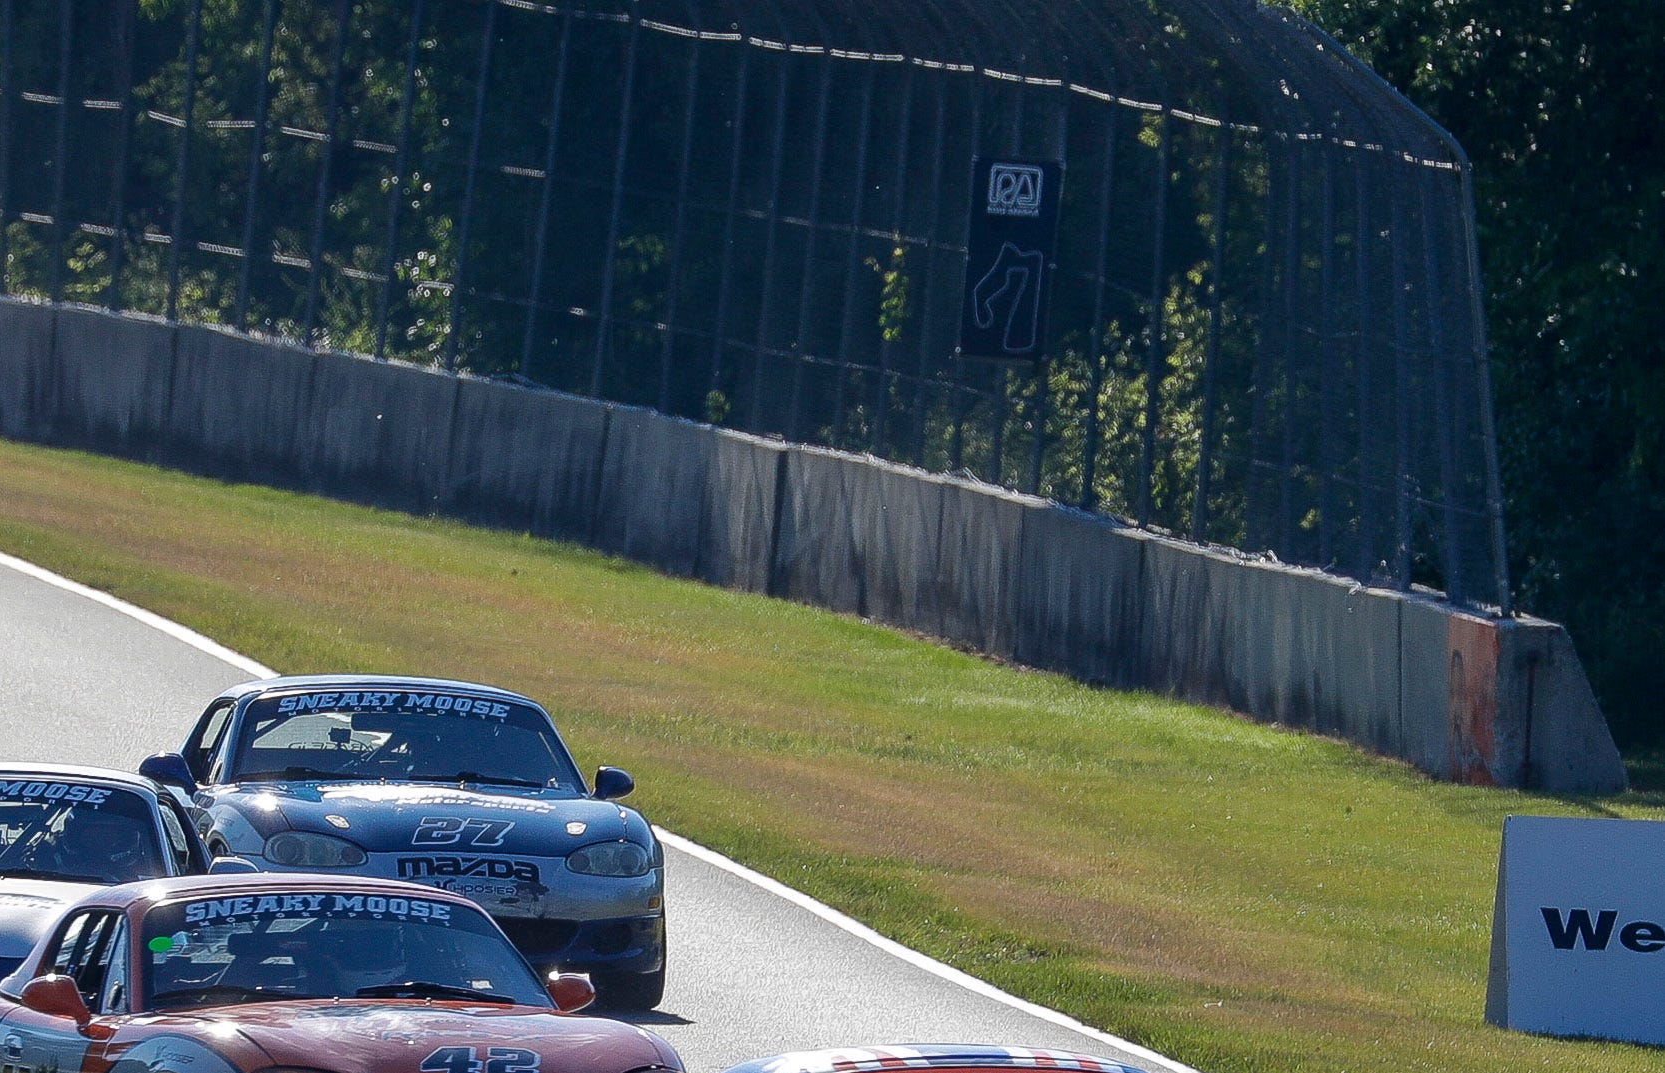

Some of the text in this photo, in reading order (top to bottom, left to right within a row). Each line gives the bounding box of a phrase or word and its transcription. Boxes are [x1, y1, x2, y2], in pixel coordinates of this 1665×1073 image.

[278, 692, 510, 718] SNEAKY MOOSE
[411, 816, 516, 846] 27
[185, 894, 451, 923] SNEAKY MOOSE
[1540, 907, 1665, 953] We
